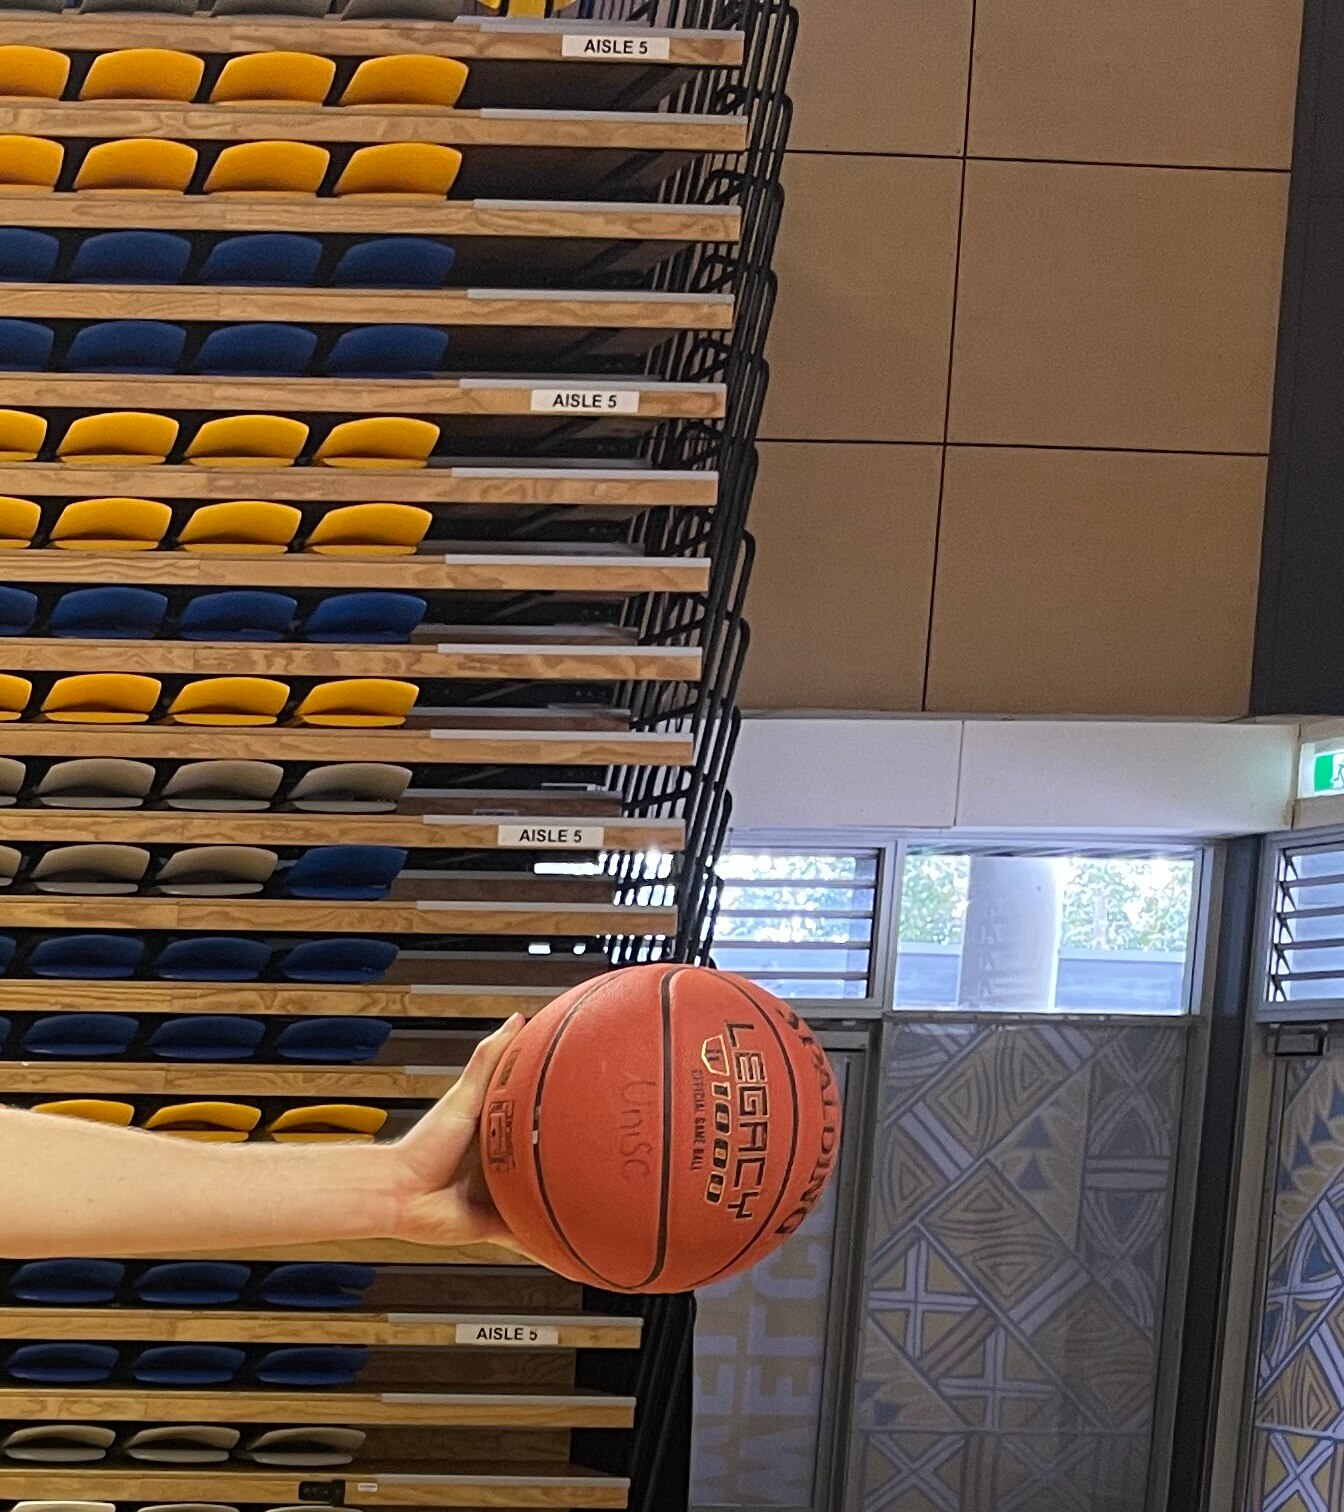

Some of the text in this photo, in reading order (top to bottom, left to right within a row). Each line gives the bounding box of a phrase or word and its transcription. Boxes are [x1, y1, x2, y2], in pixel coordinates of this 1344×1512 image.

[583, 39, 648, 55] AISLE 5
[552, 393, 617, 409] AISLE 5
[518, 828, 582, 844] AISLE 5
[724, 1021, 770, 1220] LEGACY
[693, 1116, 706, 1146] GAME
[704, 1081, 733, 1206] 1000
[690, 1148, 705, 1173] BALL
[476, 1326, 538, 1342] AISLE 5
